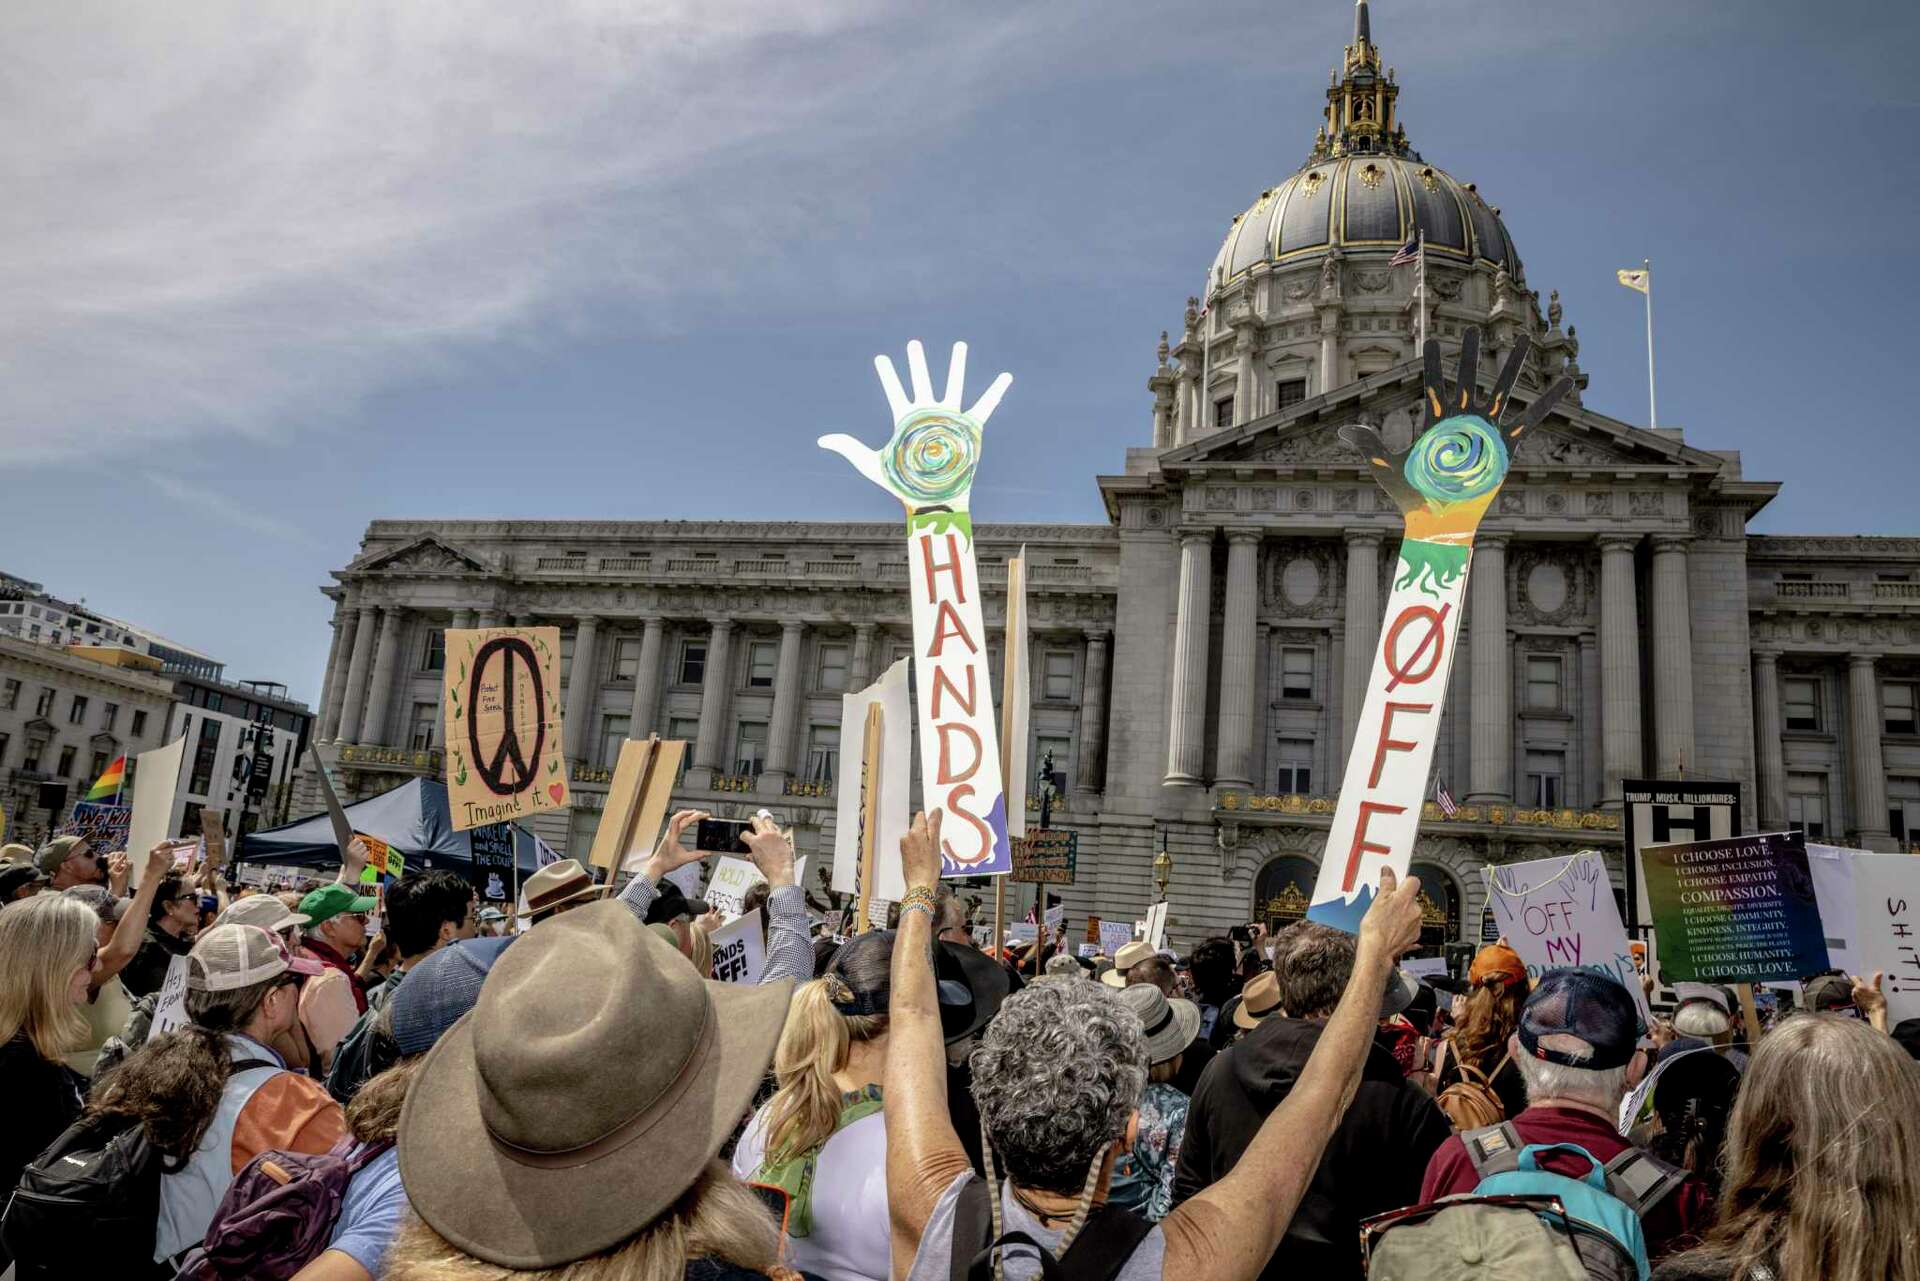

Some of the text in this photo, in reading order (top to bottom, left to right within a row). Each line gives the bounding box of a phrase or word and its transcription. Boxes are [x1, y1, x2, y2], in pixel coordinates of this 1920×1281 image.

[919, 533, 992, 864] HANDS
[464, 786, 548, 827] Imagine it.
[1625, 792, 1737, 804] TRUMP, MUSK, BILLIONAIRES:
[1652, 805, 1711, 843] H
[474, 853, 491, 865] THE
[1681, 848, 1734, 863] CHOOSE
[1735, 844, 1774, 858] LOVE.
[1681, 863, 1721, 876] CHOOSE
[1684, 875, 1727, 887] CHOOSE
[1728, 870, 1777, 883] EMPATHY
[1681, 884, 1782, 904] COMPASSION.
[1523, 901, 1573, 936] OFF
[1690, 913, 1726, 924] CHOOSE
[1728, 910, 1787, 921] COMMUNITY.
[1546, 932, 1581, 967] MY
[1697, 952, 1738, 962] CHOOSE
[1739, 949, 1795, 960] HUMANITY.
[1702, 964, 1756, 977] CHOOSE
[1759, 961, 1797, 974] LOVE.
